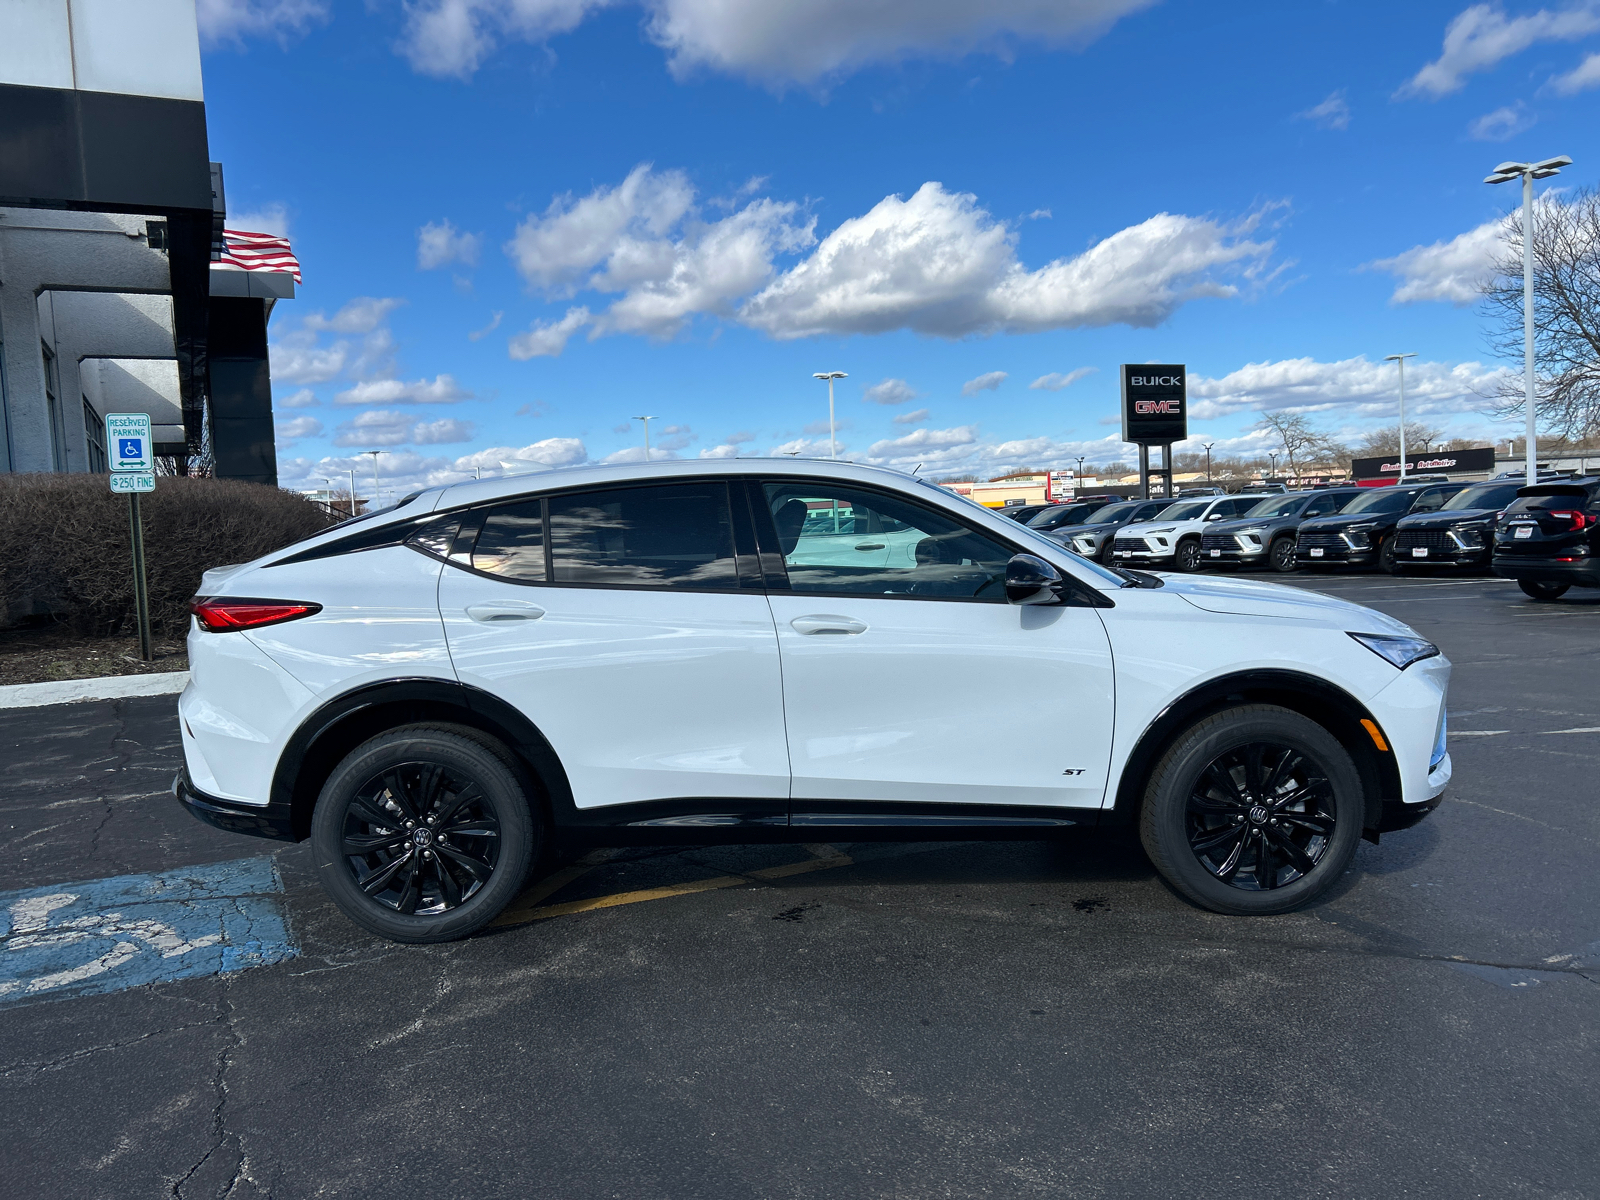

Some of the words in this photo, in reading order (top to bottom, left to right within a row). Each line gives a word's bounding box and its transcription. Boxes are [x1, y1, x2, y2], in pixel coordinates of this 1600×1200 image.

[1131, 376, 1181, 386] BUICK
[1135, 400, 1180, 414] GMC
[109, 418, 148, 427] RESERVED
[112, 428, 146, 437] PARKING
[1381, 463, 1414, 471] Maximm
[112, 477, 135, 489] $250
[137, 476, 153, 488] FINE
[1062, 768, 1086, 776] ST
